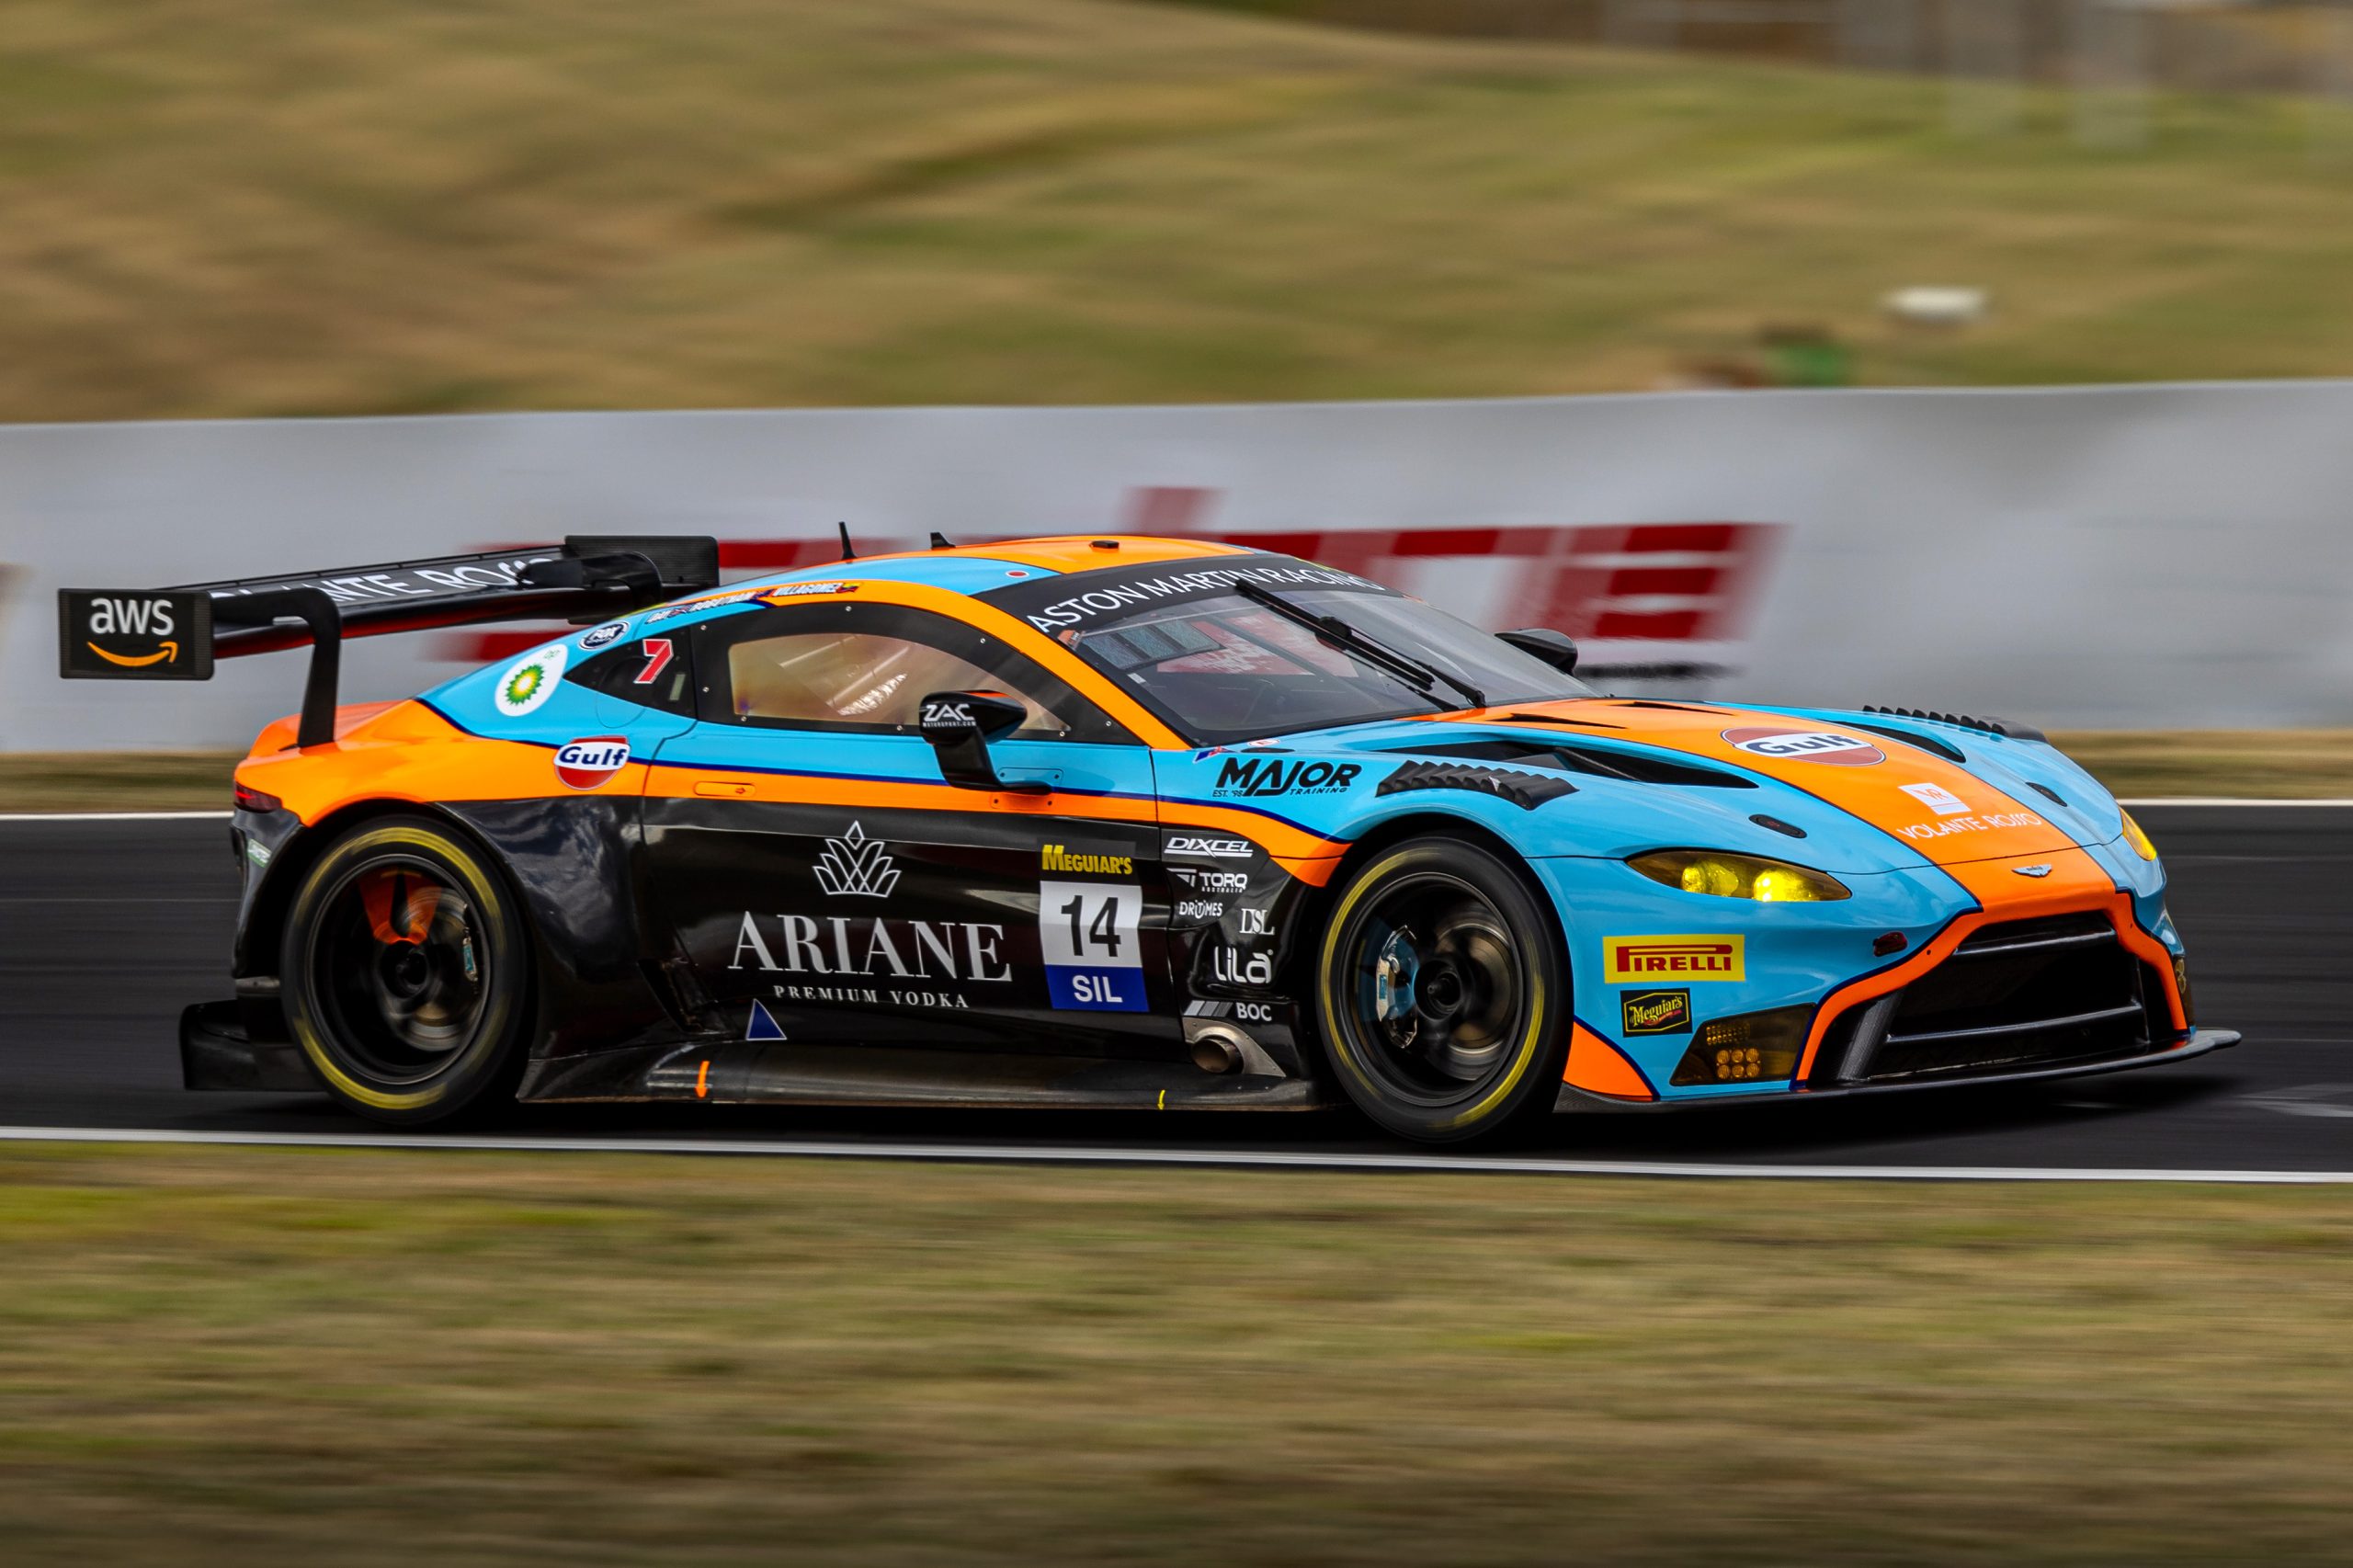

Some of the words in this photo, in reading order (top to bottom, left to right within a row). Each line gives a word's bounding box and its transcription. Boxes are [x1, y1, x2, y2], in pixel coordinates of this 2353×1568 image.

[1027, 585, 1134, 633] ASTON
[1134, 569, 1266, 597] MARTIN
[1256, 568, 1386, 591] RACING
[90, 597, 175, 636] aws
[632, 639, 673, 685] 7
[924, 703, 975, 722] ZAC
[559, 745, 627, 766] Gulf
[1746, 734, 1863, 755] Gulf
[1215, 757, 1362, 797] MAJOR
[1290, 787, 1348, 796] TRAINING
[1896, 816, 1989, 840] VOLANTE
[1042, 844, 1133, 875] MEGUIAR'S
[1165, 836, 1254, 857] DIXCEL
[1199, 871, 1248, 891] TORQ
[1061, 894, 1122, 958] 14
[1239, 908, 1276, 936] DSL
[727, 910, 1013, 982] ARIANE
[1616, 944, 1733, 972] PIRELLI
[773, 984, 879, 1004] PREMIUM
[890, 990, 970, 1008] VODKA
[1072, 974, 1123, 1004] SIL
[1235, 1002, 1273, 1021] BOC
[1629, 995, 1683, 1028] Meguiar's
